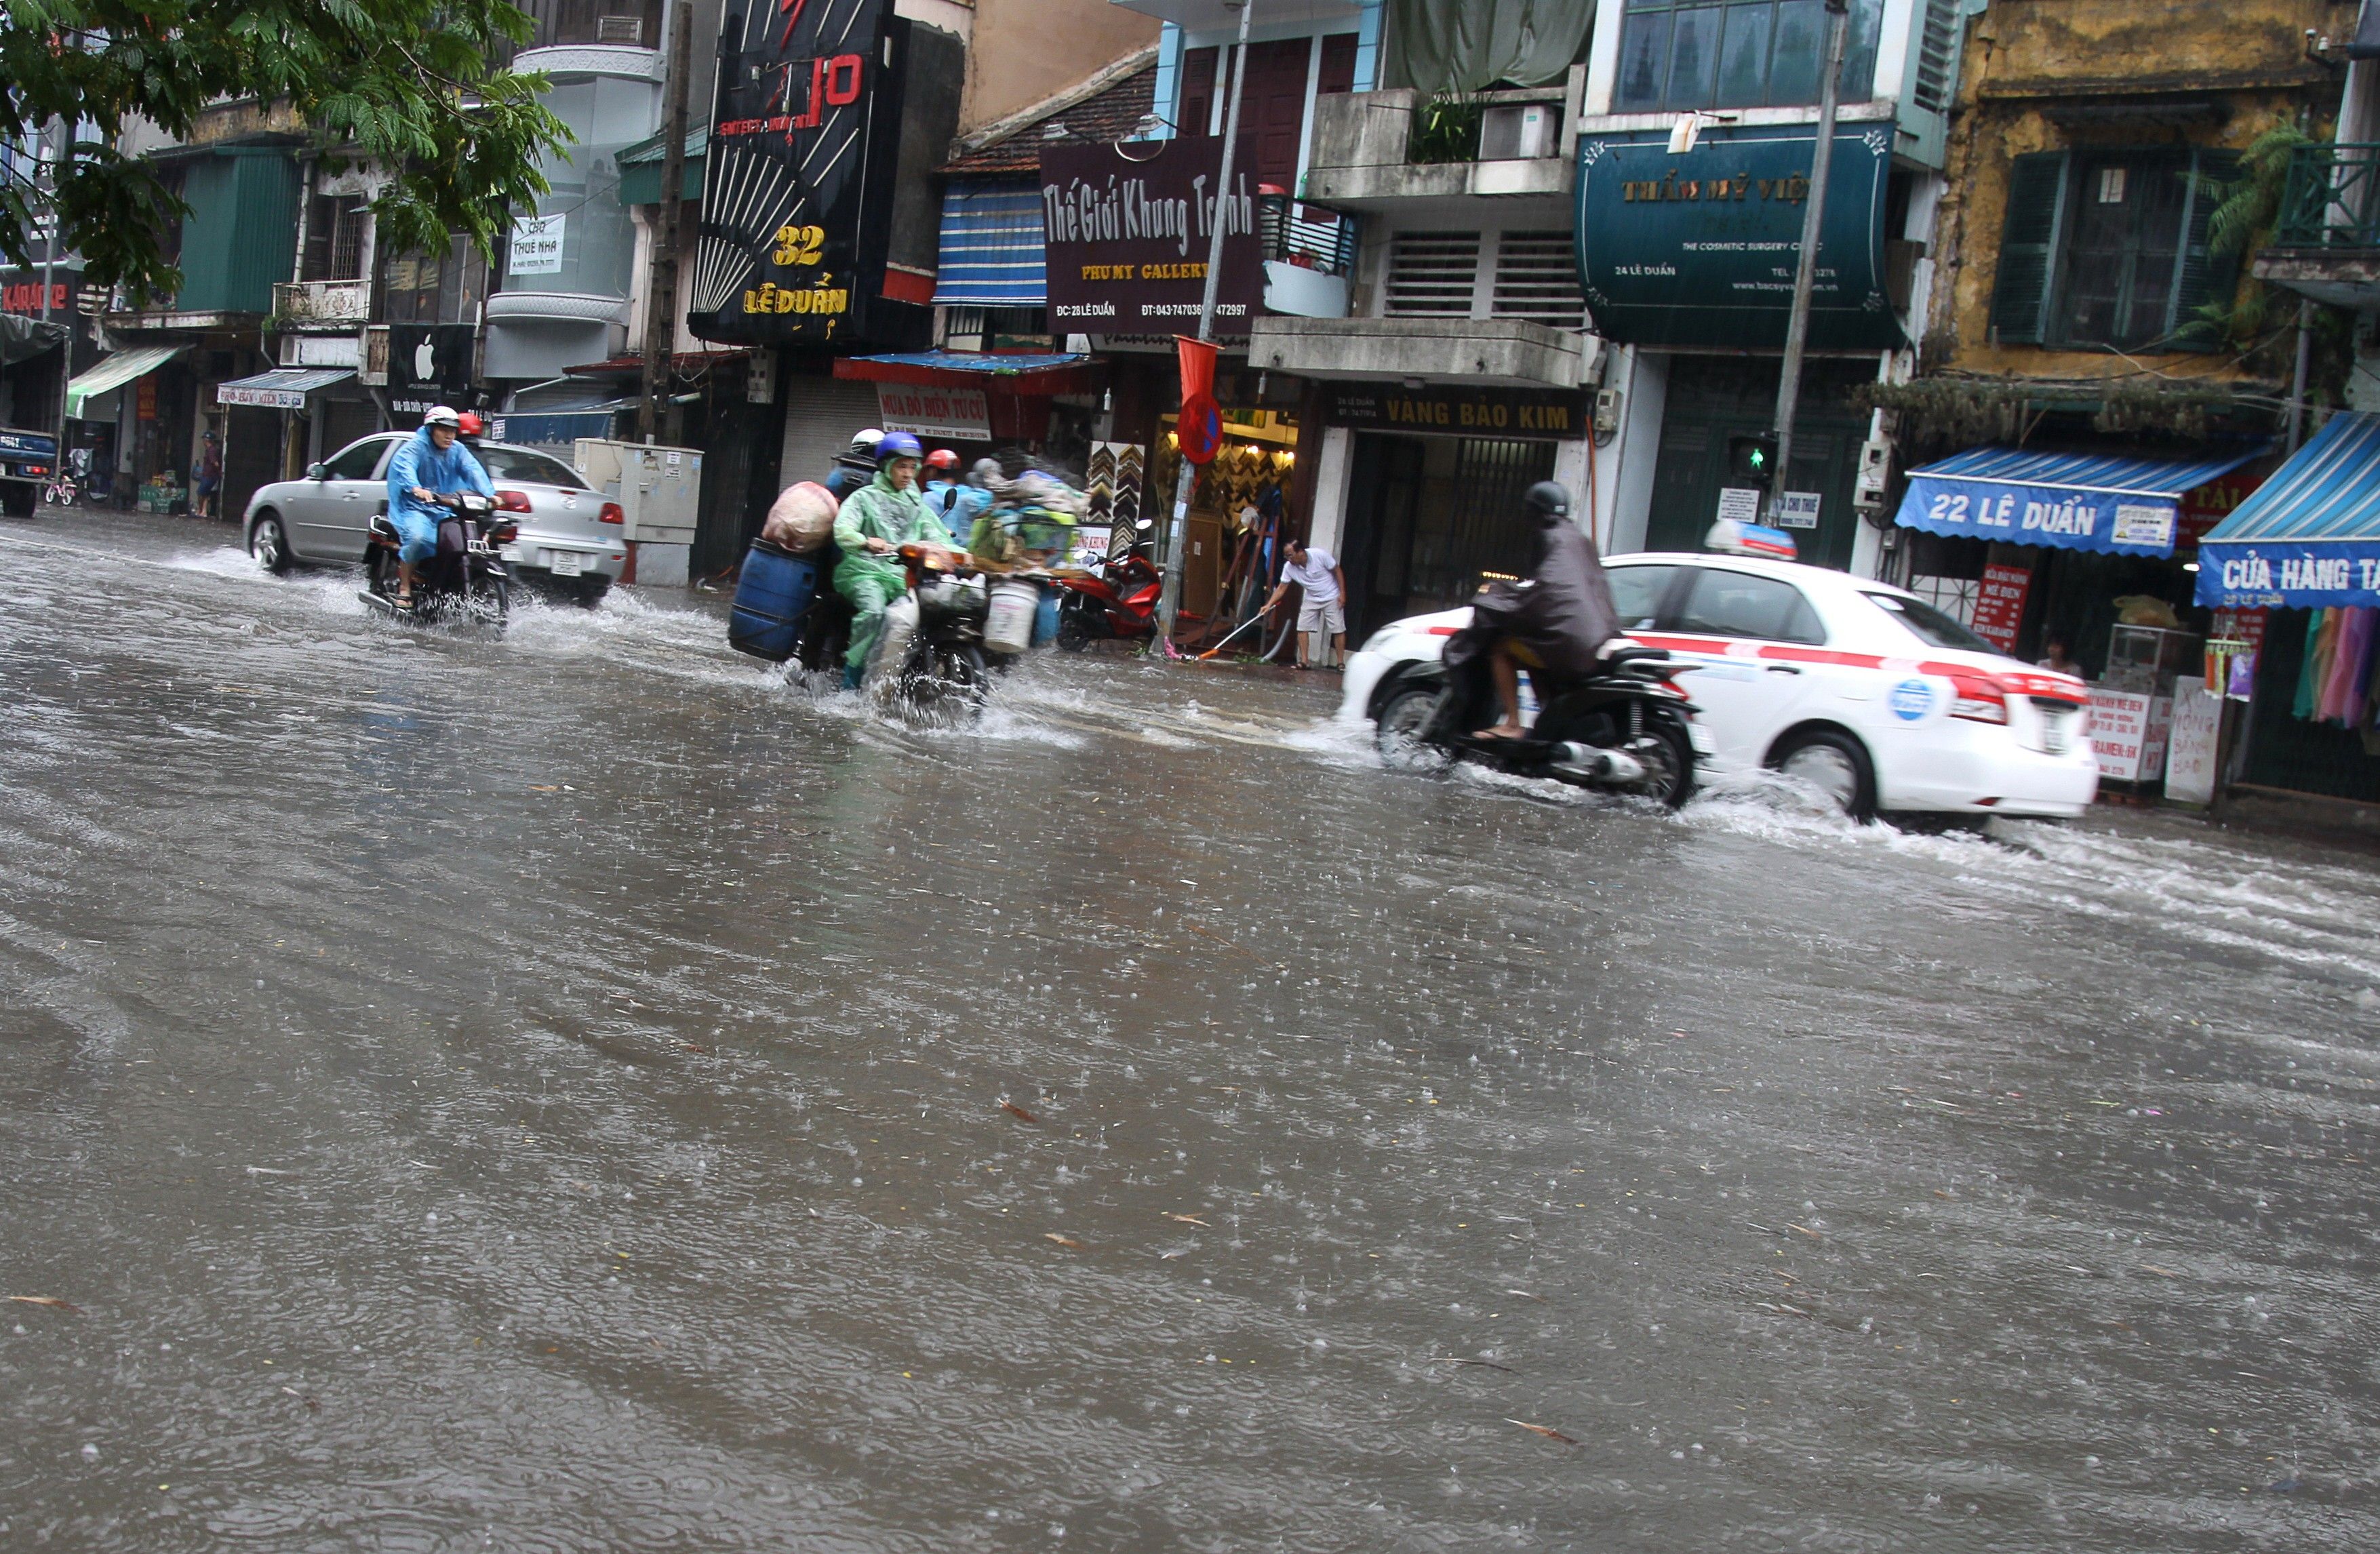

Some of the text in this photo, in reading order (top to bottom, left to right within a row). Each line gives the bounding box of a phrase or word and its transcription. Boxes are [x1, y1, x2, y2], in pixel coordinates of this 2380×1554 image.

[719, 113, 809, 136] ENTERTINMNT
[1758, 171, 1811, 206] VIỆ
[1044, 173, 1252, 256] Thế Giới Khung Trnh
[529, 221, 545, 234] CHO
[772, 225, 825, 266] 32
[1682, 242, 1698, 251] THE
[1699, 242, 1745, 251] COSMETIC
[1747, 242, 1788, 251] SURGERY
[1082, 263, 1209, 280] PHU MY GALLERY
[1615, 266, 1627, 275] 24
[1629, 263, 1642, 275] LÊ
[743, 272, 848, 315] LÊ DUẨN
[1071, 305, 1080, 316] 28
[1082, 302, 1091, 316] LÊ
[1216, 304, 1246, 315] 472997
[883, 393, 905, 416] MUA
[1387, 394, 1570, 430] VÀNG BẢO KIM
[1928, 494, 1970, 523] 22
[1977, 493, 2015, 527] LÊ
[2021, 495, 2097, 536] DUẨN
[2222, 550, 2273, 590] CỬA
[2280, 552, 2351, 591] HÀNG
